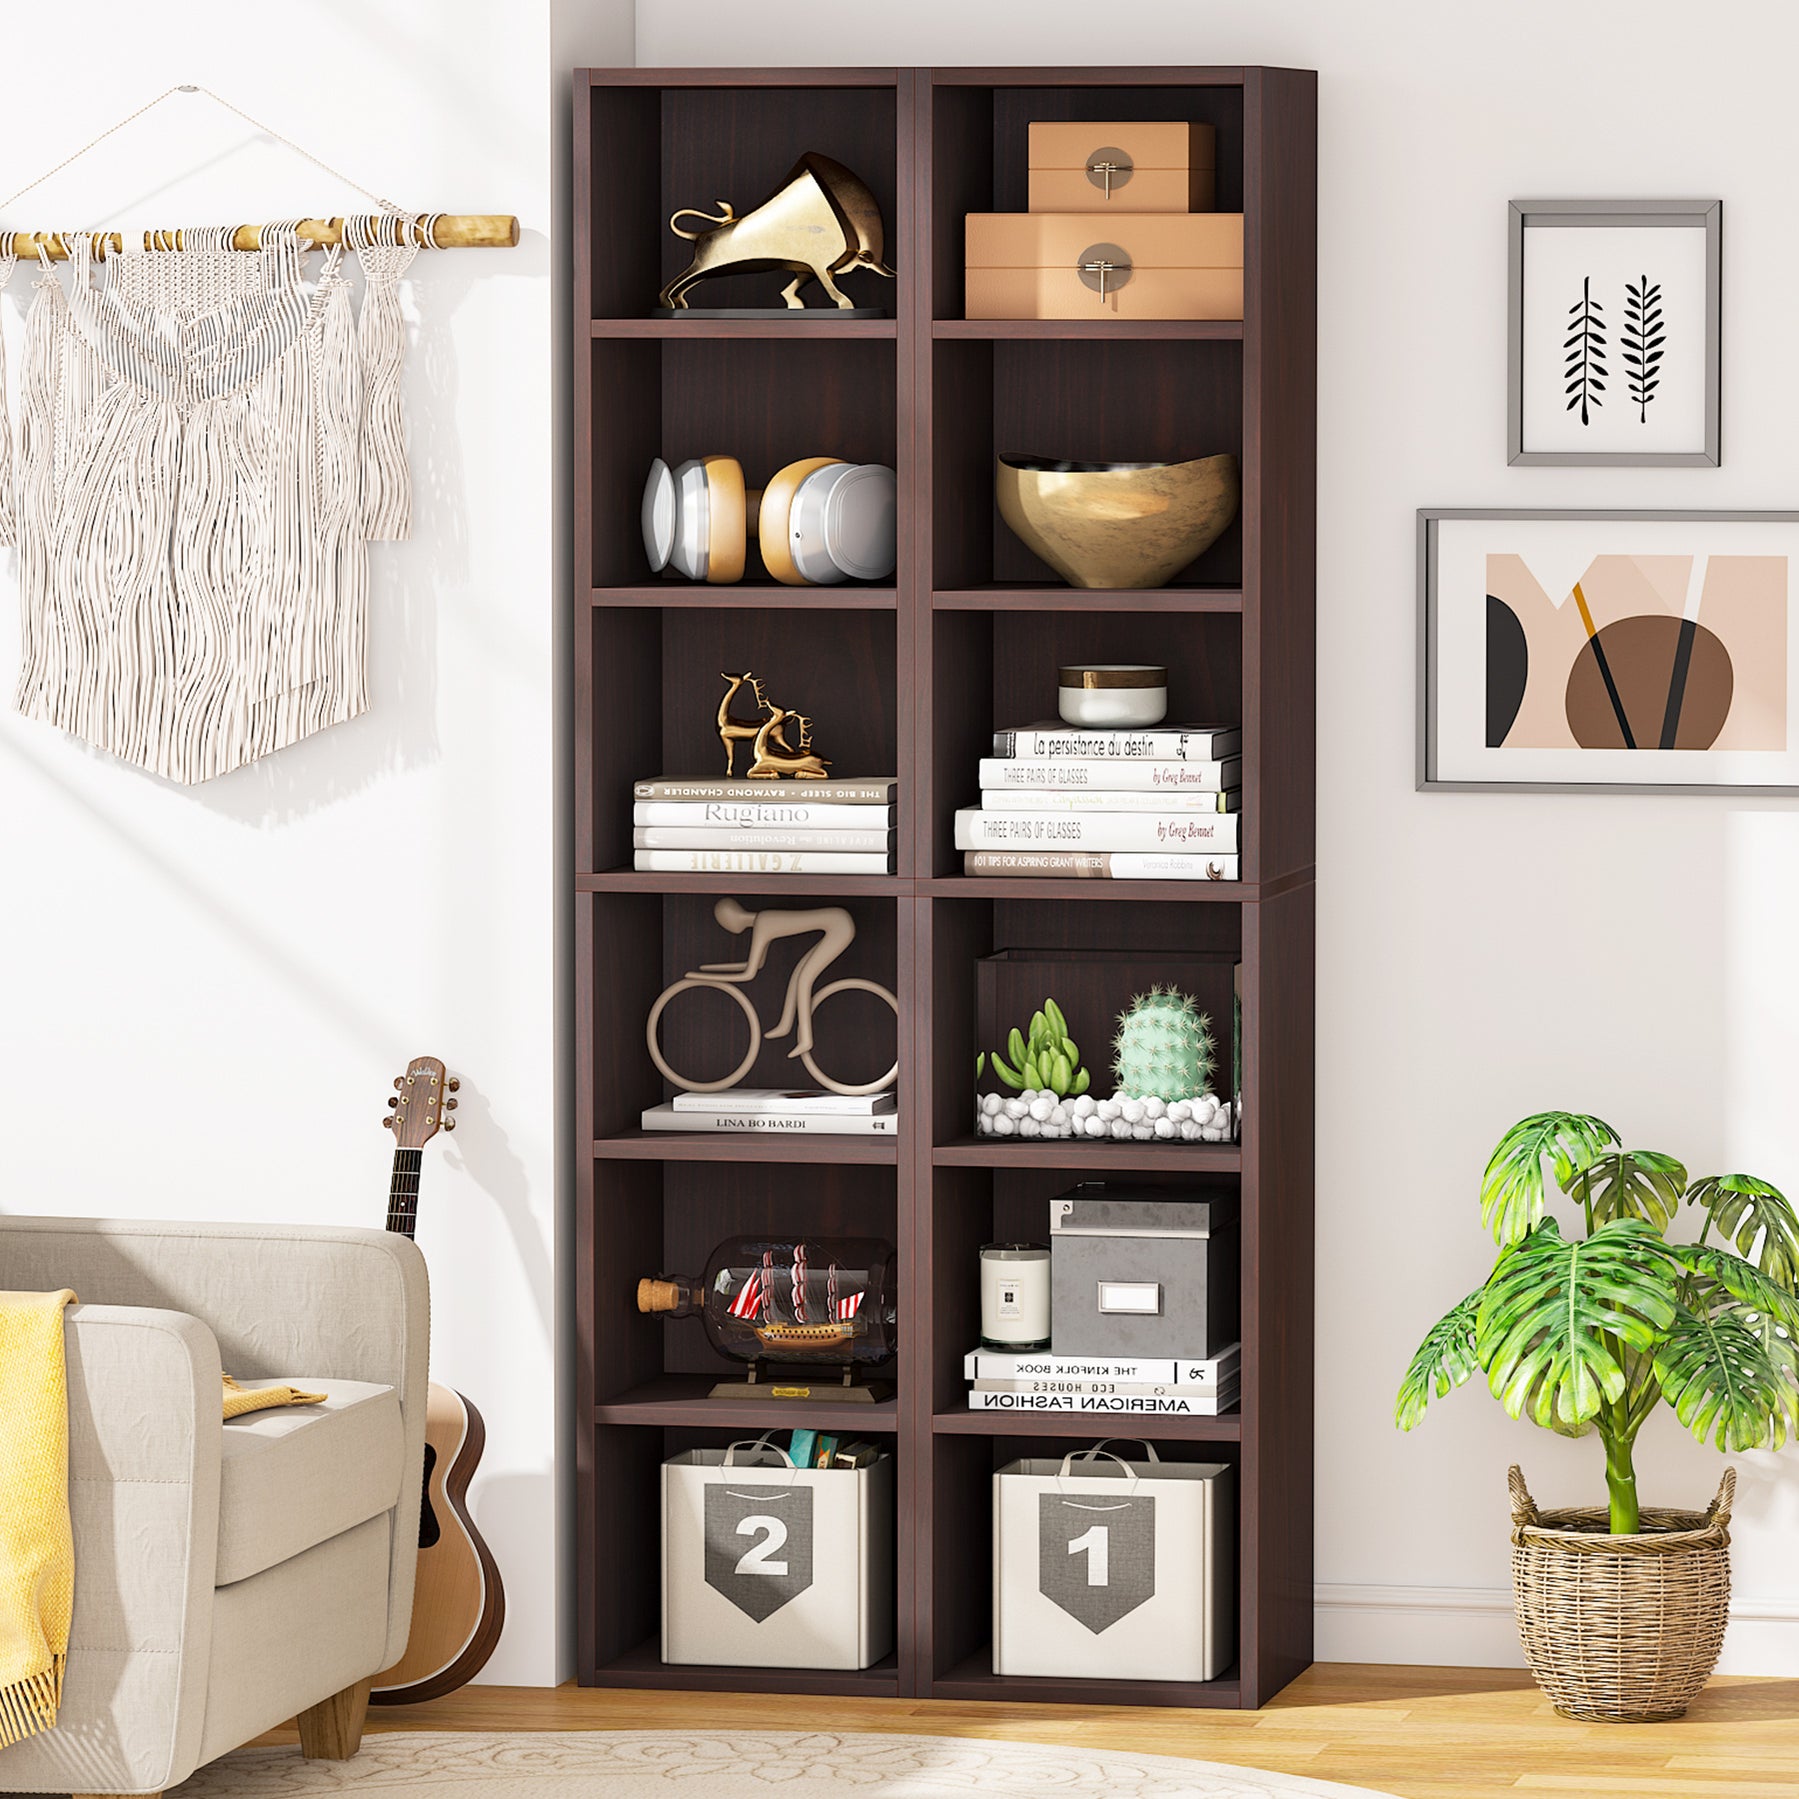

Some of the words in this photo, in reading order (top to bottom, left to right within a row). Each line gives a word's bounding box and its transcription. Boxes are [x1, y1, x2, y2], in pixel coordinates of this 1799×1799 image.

[1034, 732, 1045, 755] La
[1107, 733, 1121, 756] du
[1124, 733, 1154, 756] destin
[1004, 767, 1024, 783] THREE
[1027, 768, 1045, 783] PAIRS
[1048, 768, 1056, 783] OF
[1059, 768, 1088, 784] GLASSES
[1152, 767, 1160, 785] by
[1162, 768, 1178, 786] Greg
[663, 787, 723, 796] CHANDLER
[727, 789, 786, 798] RAYMOND
[801, 790, 832, 798] SLEEP
[836, 790, 856, 798] BIG
[860, 790, 880, 798] THE
[705, 803, 809, 829] Rugiano
[983, 820, 1007, 838] THREE
[1010, 820, 1032, 839] PAIRS
[1034, 821, 1044, 838] OF
[1047, 821, 1081, 839] GLASSES
[1157, 821, 1166, 842] by
[1168, 822, 1186, 842] Greg
[731, 835, 796, 846] Revolution
[691, 852, 782, 872] GALLERIE
[790, 853, 802, 872] Z
[974, 856, 986, 867] 101
[988, 856, 1001, 867] TIPS
[1002, 857, 1016, 867] FOR
[1017, 857, 1048, 868] ASPIRING
[1050, 857, 1073, 868] GRANT
[1075, 857, 1103, 869] WRITERS
[716, 1118, 745, 1128] LINA
[748, 1118, 765, 1128] BO
[769, 1119, 806, 1129] BARDI
[734, 1515, 788, 1576] 2
[1068, 1525, 1108, 1586] 1
